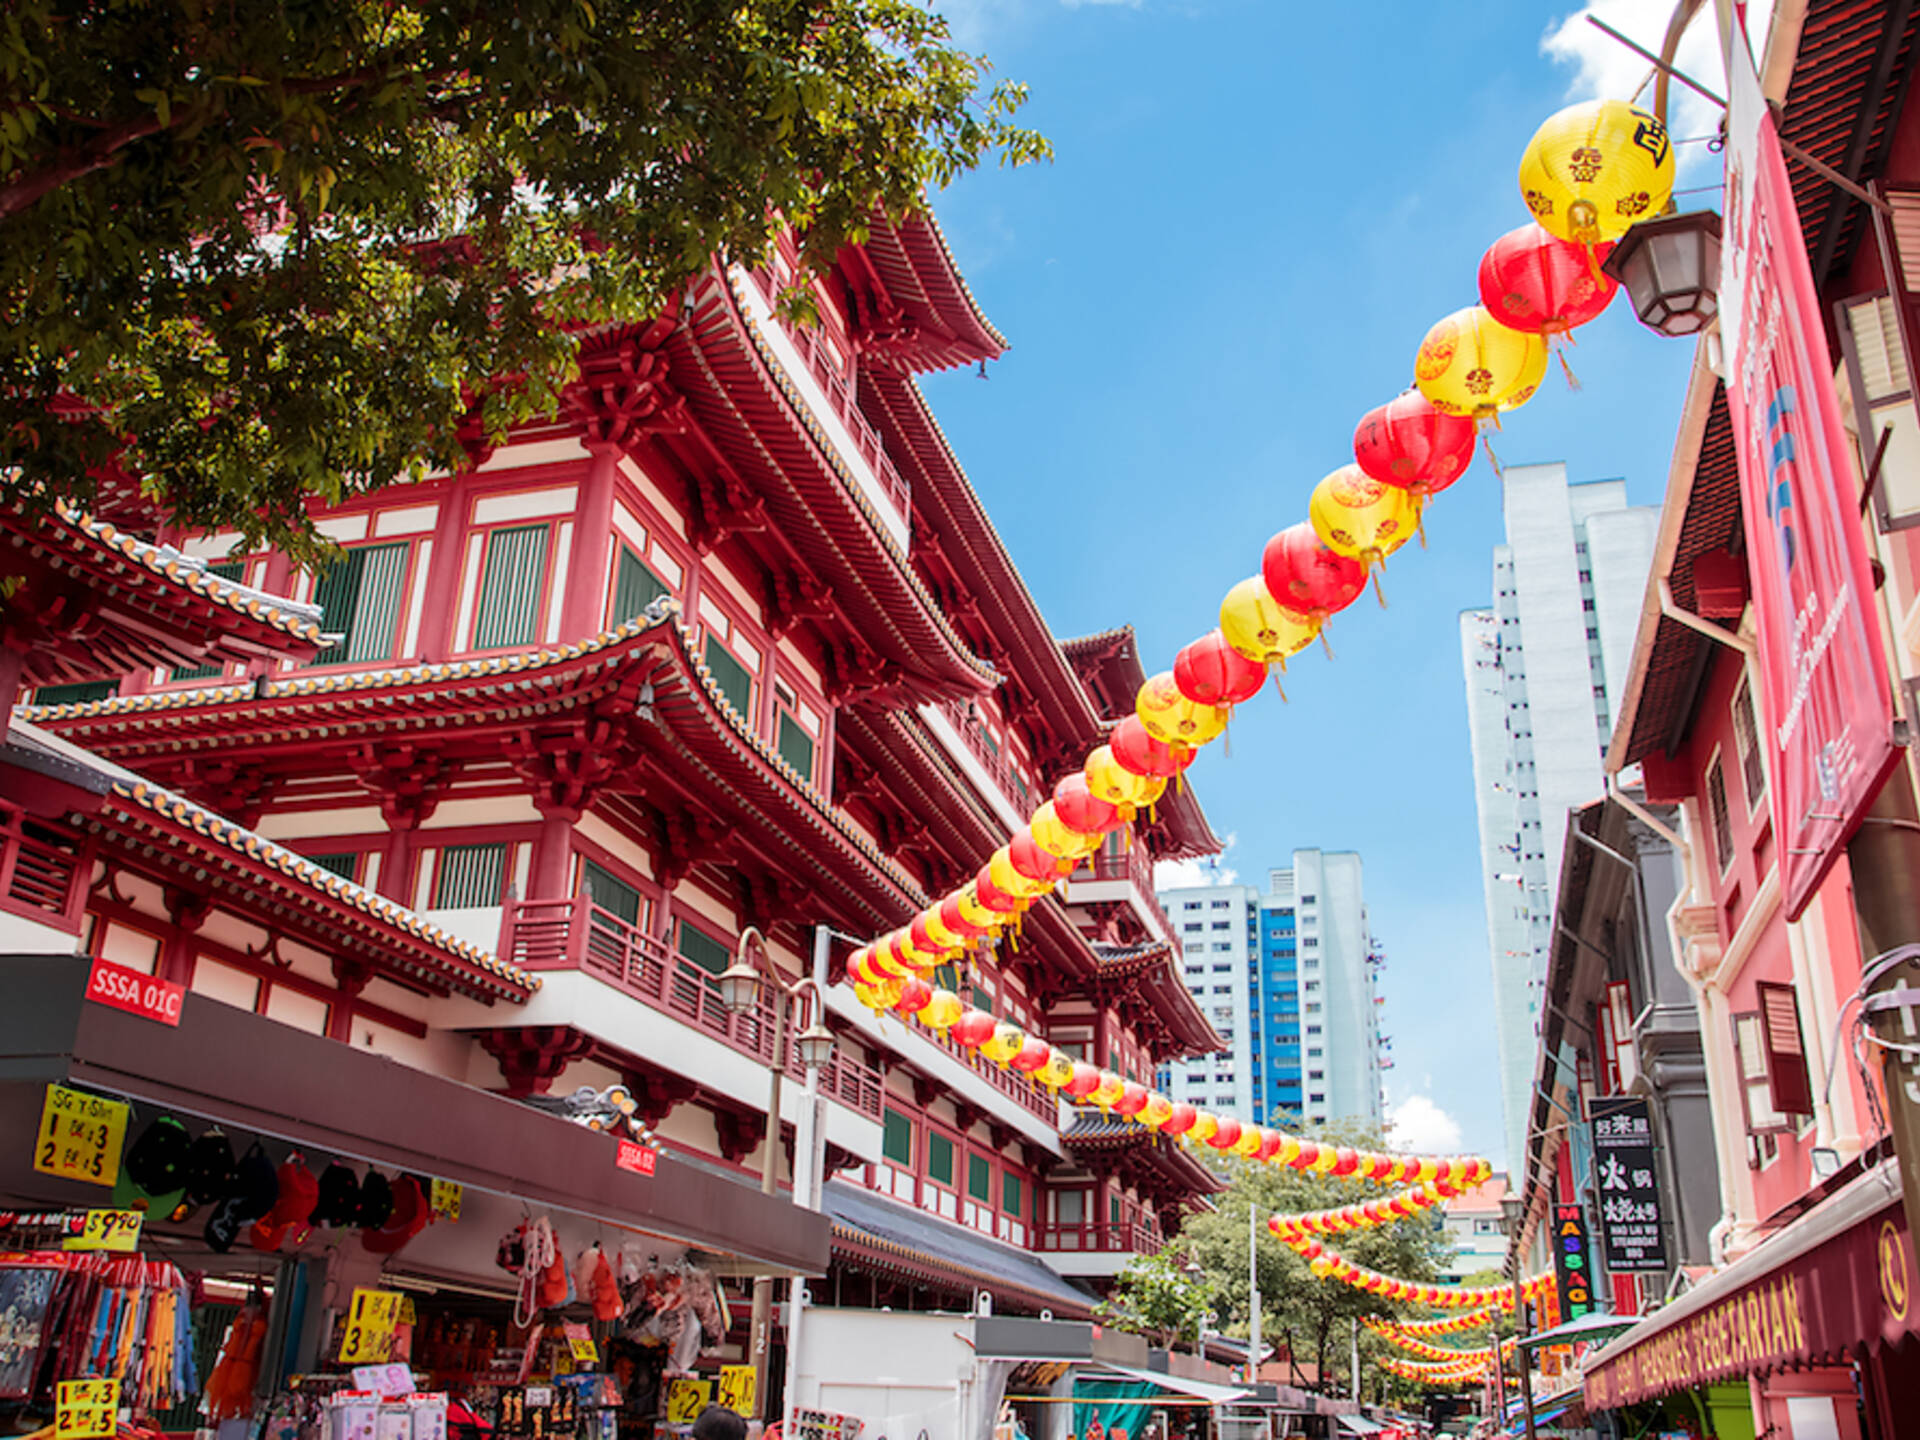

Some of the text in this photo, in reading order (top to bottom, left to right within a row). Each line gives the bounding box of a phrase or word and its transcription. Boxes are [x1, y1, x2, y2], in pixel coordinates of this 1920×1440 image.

[93, 968, 179, 1017] SSSA 01C
[41, 1141, 56, 1168] 2
[1557, 1206, 1588, 1320] MASSAGE
[346, 1327, 361, 1357] 3
[1691, 1272, 1804, 1374] VEGETARIAN
[59, 1410, 72, 1430] 2
